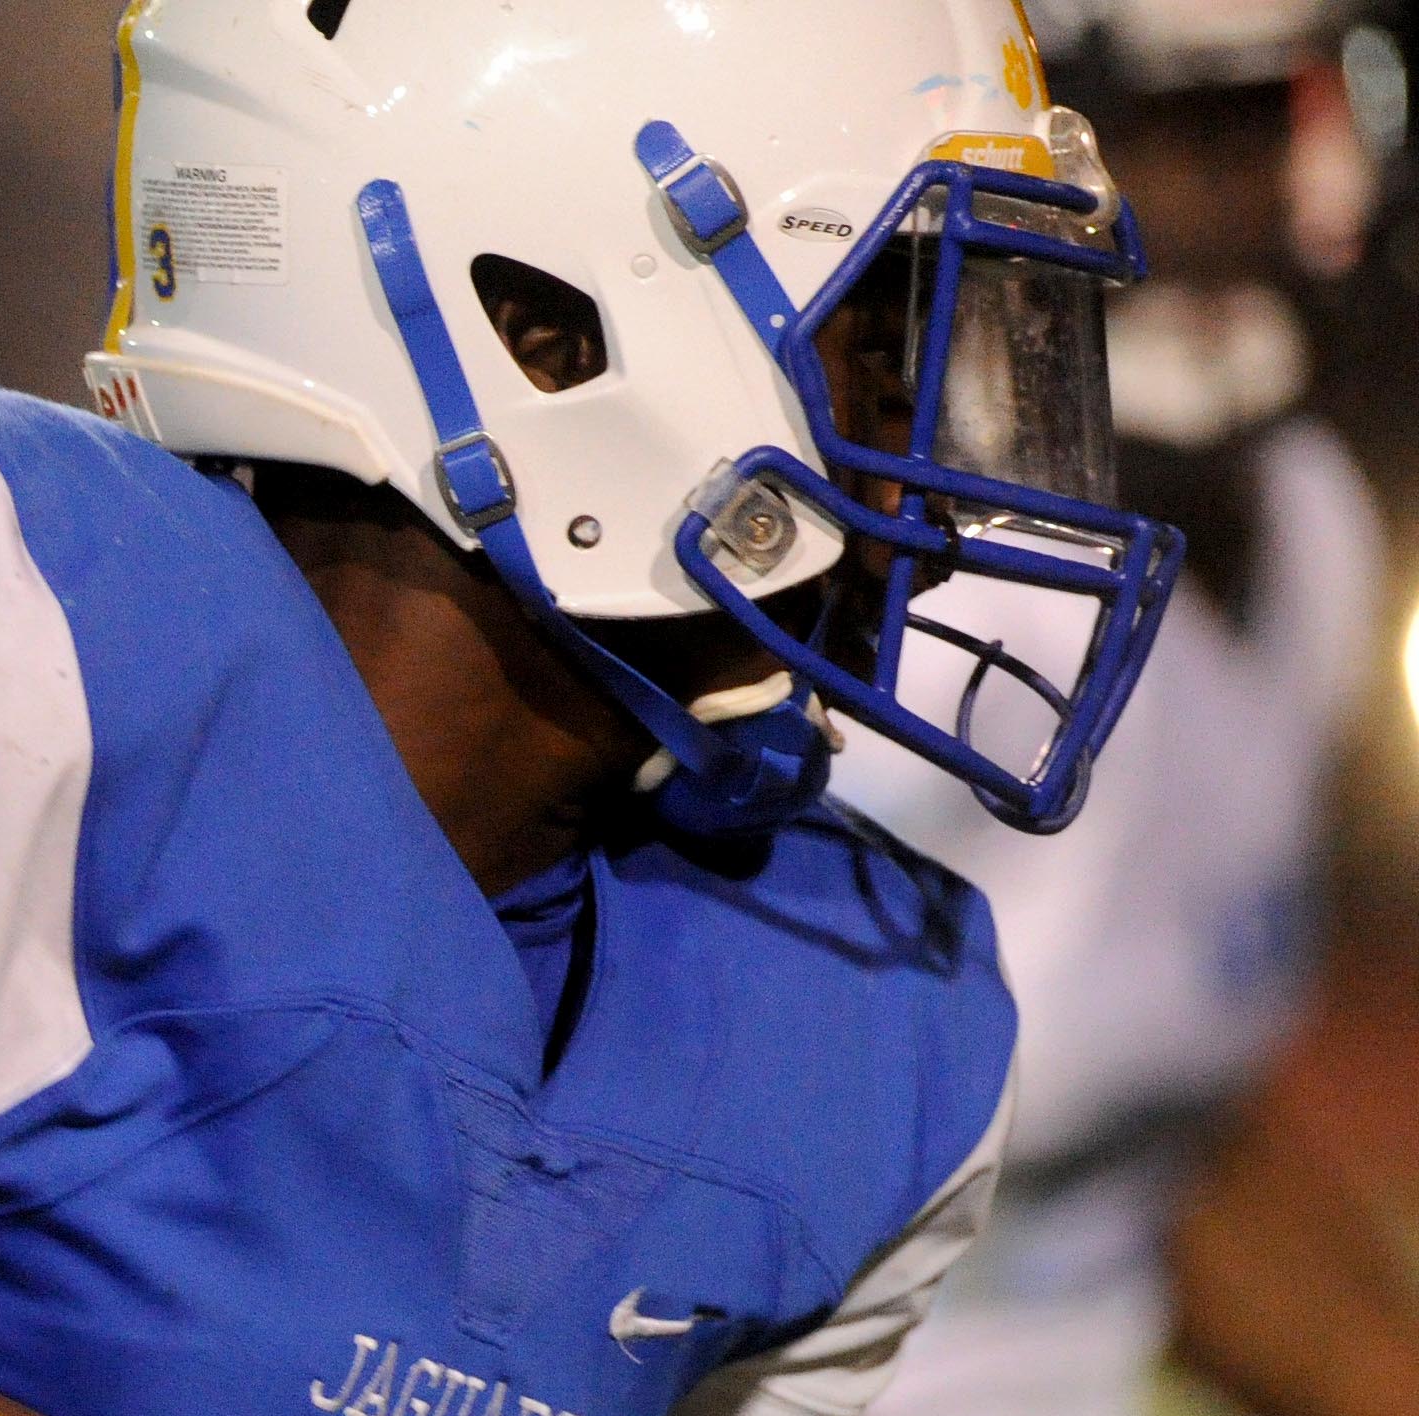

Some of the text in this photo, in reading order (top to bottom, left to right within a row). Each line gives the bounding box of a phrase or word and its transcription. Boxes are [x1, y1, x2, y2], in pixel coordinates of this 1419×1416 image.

[174, 167, 228, 183] WARNING
[781, 215, 853, 238] SPEED
[148, 223, 176, 301] 3
